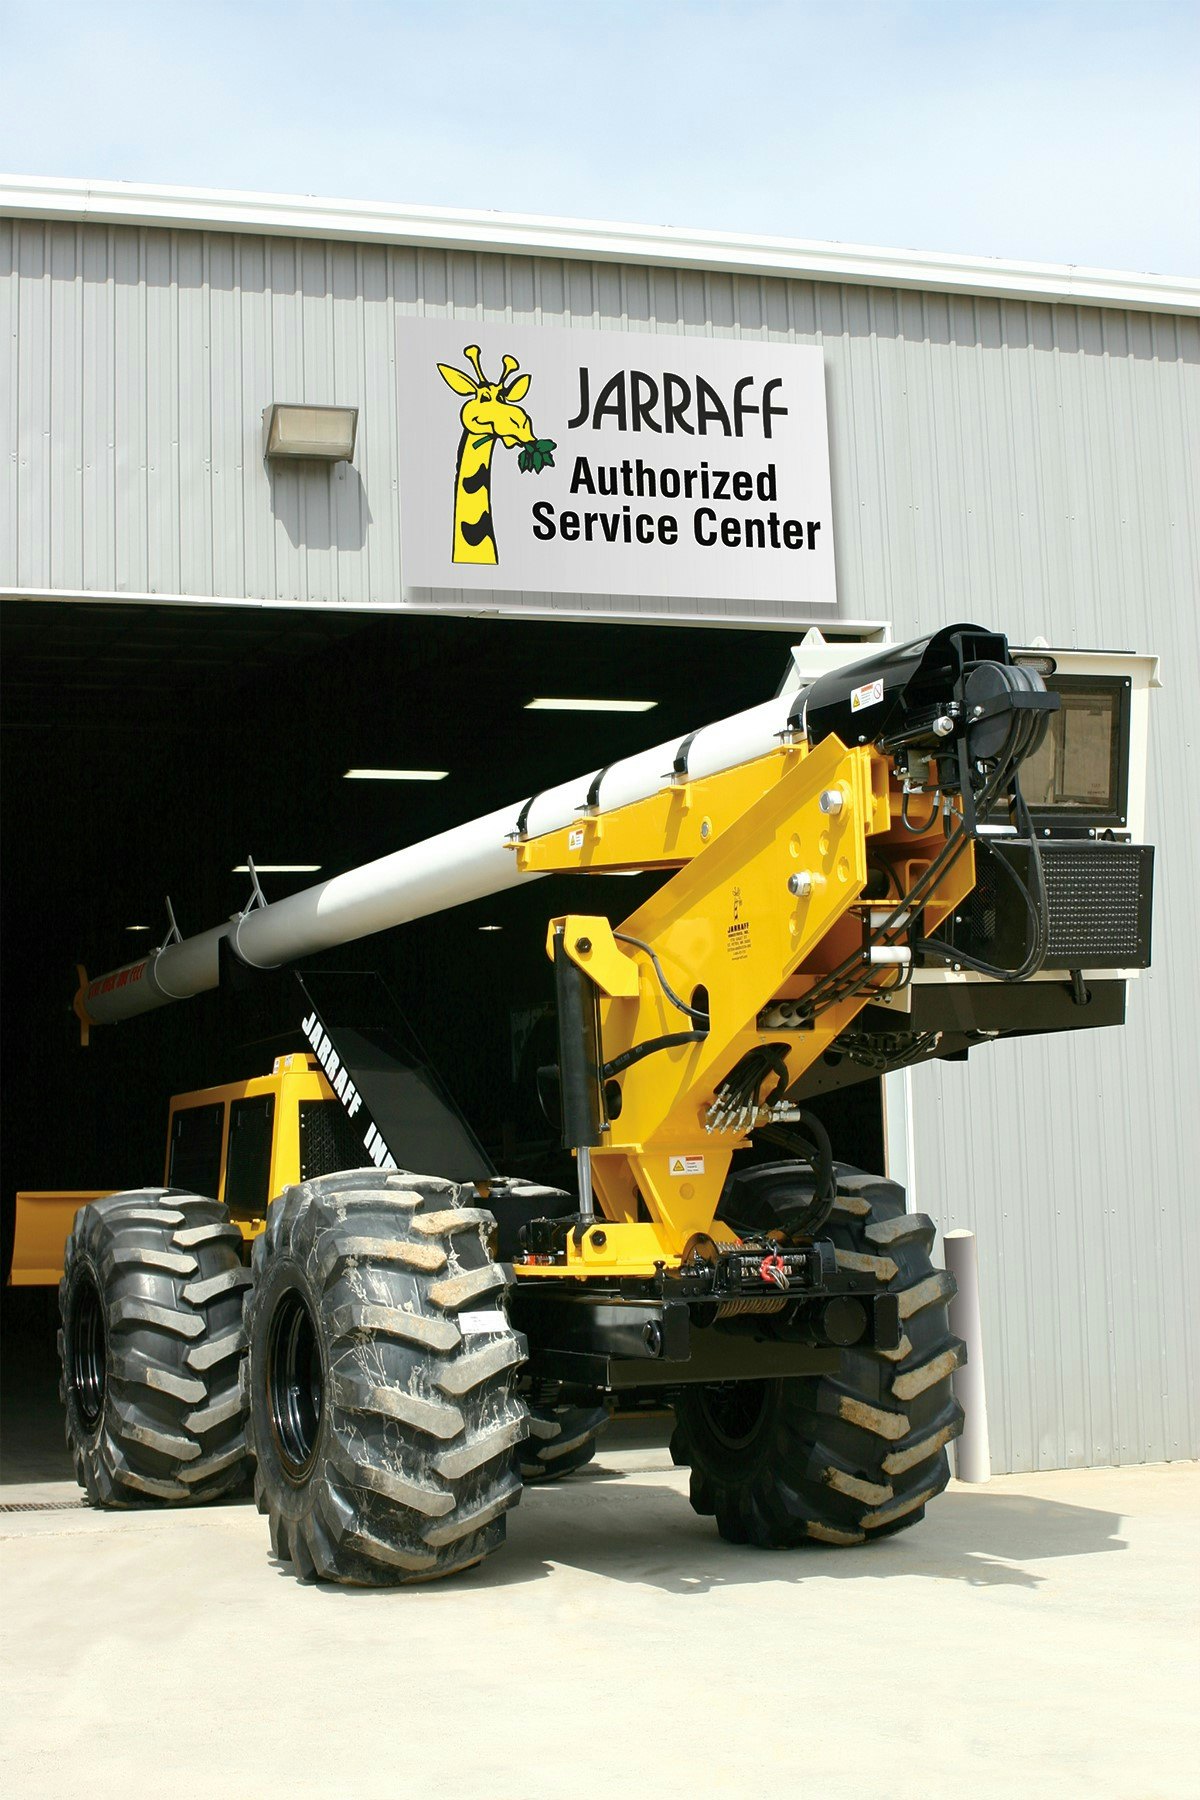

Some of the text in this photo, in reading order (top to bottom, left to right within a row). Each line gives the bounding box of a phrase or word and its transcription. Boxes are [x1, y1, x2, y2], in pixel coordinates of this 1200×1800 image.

[567, 366, 789, 439] JARRAFF
[570, 456, 777, 501] Authorized
[532, 501, 821, 550] Service Center
[301, 1011, 363, 1118] JARRAFF
